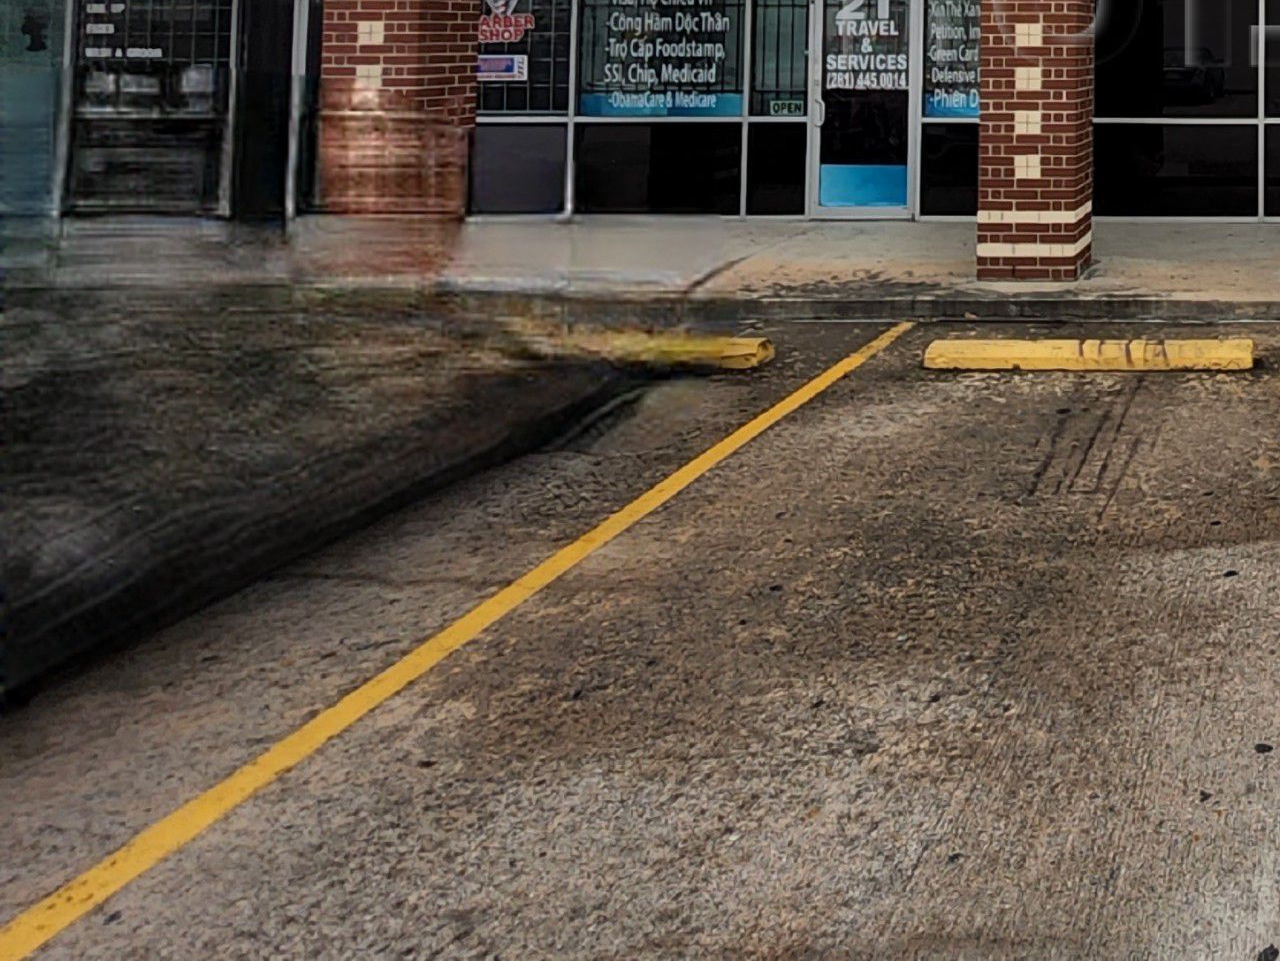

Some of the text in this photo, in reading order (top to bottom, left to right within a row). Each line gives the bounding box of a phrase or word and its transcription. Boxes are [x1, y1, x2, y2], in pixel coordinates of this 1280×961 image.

[481, 14, 534, 29] ARBER
[835, 20, 899, 36] TRAVEL
[480, 29, 523, 41] SHOP
[861, 37, 873, 53] &
[826, 54, 907, 71] SERVICES
[661, 63, 716, 83] Medicaid
[675, 91, 716, 108] Medicare
[773, 102, 803, 114] OPEN
